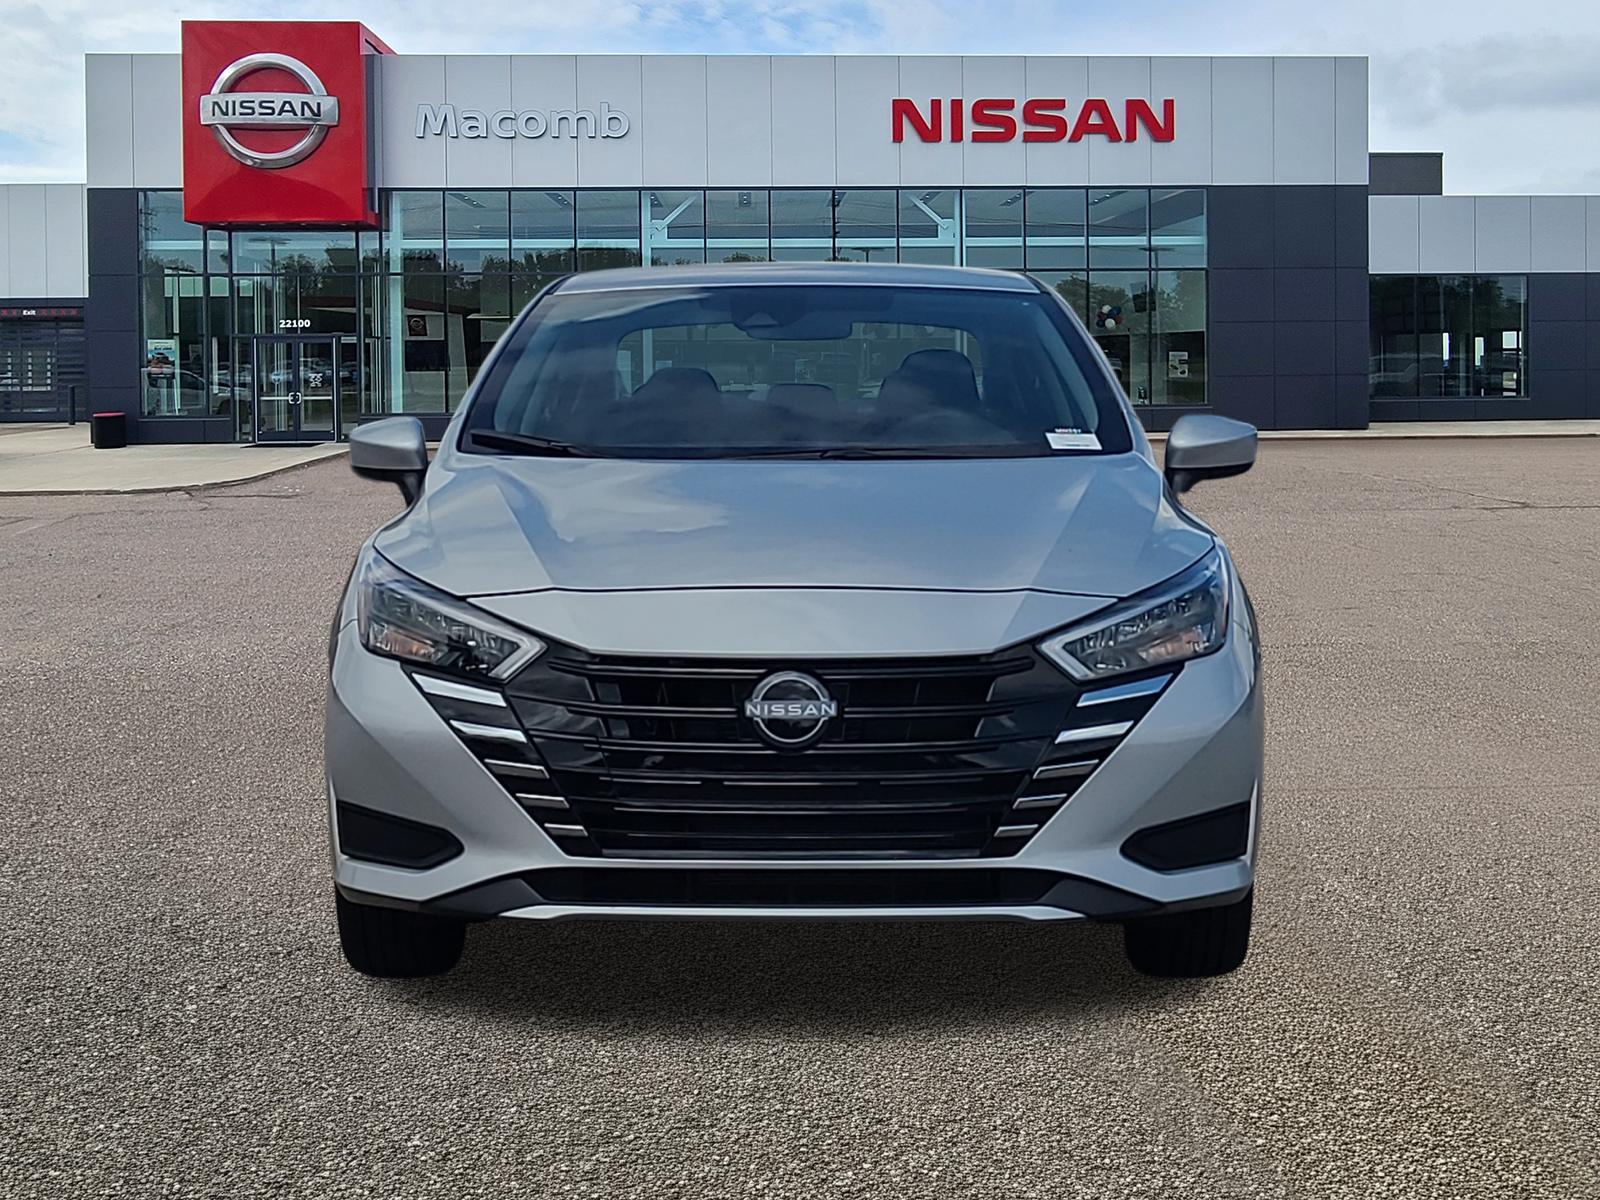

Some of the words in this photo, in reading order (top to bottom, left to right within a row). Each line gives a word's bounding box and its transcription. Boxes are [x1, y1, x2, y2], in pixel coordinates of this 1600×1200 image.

[211, 99, 322, 118] NISSAN
[415, 101, 630, 139] Macomb
[892, 98, 1176, 143] NISSAN
[279, 319, 311, 328] 22100
[745, 703, 835, 717] NISSAN
